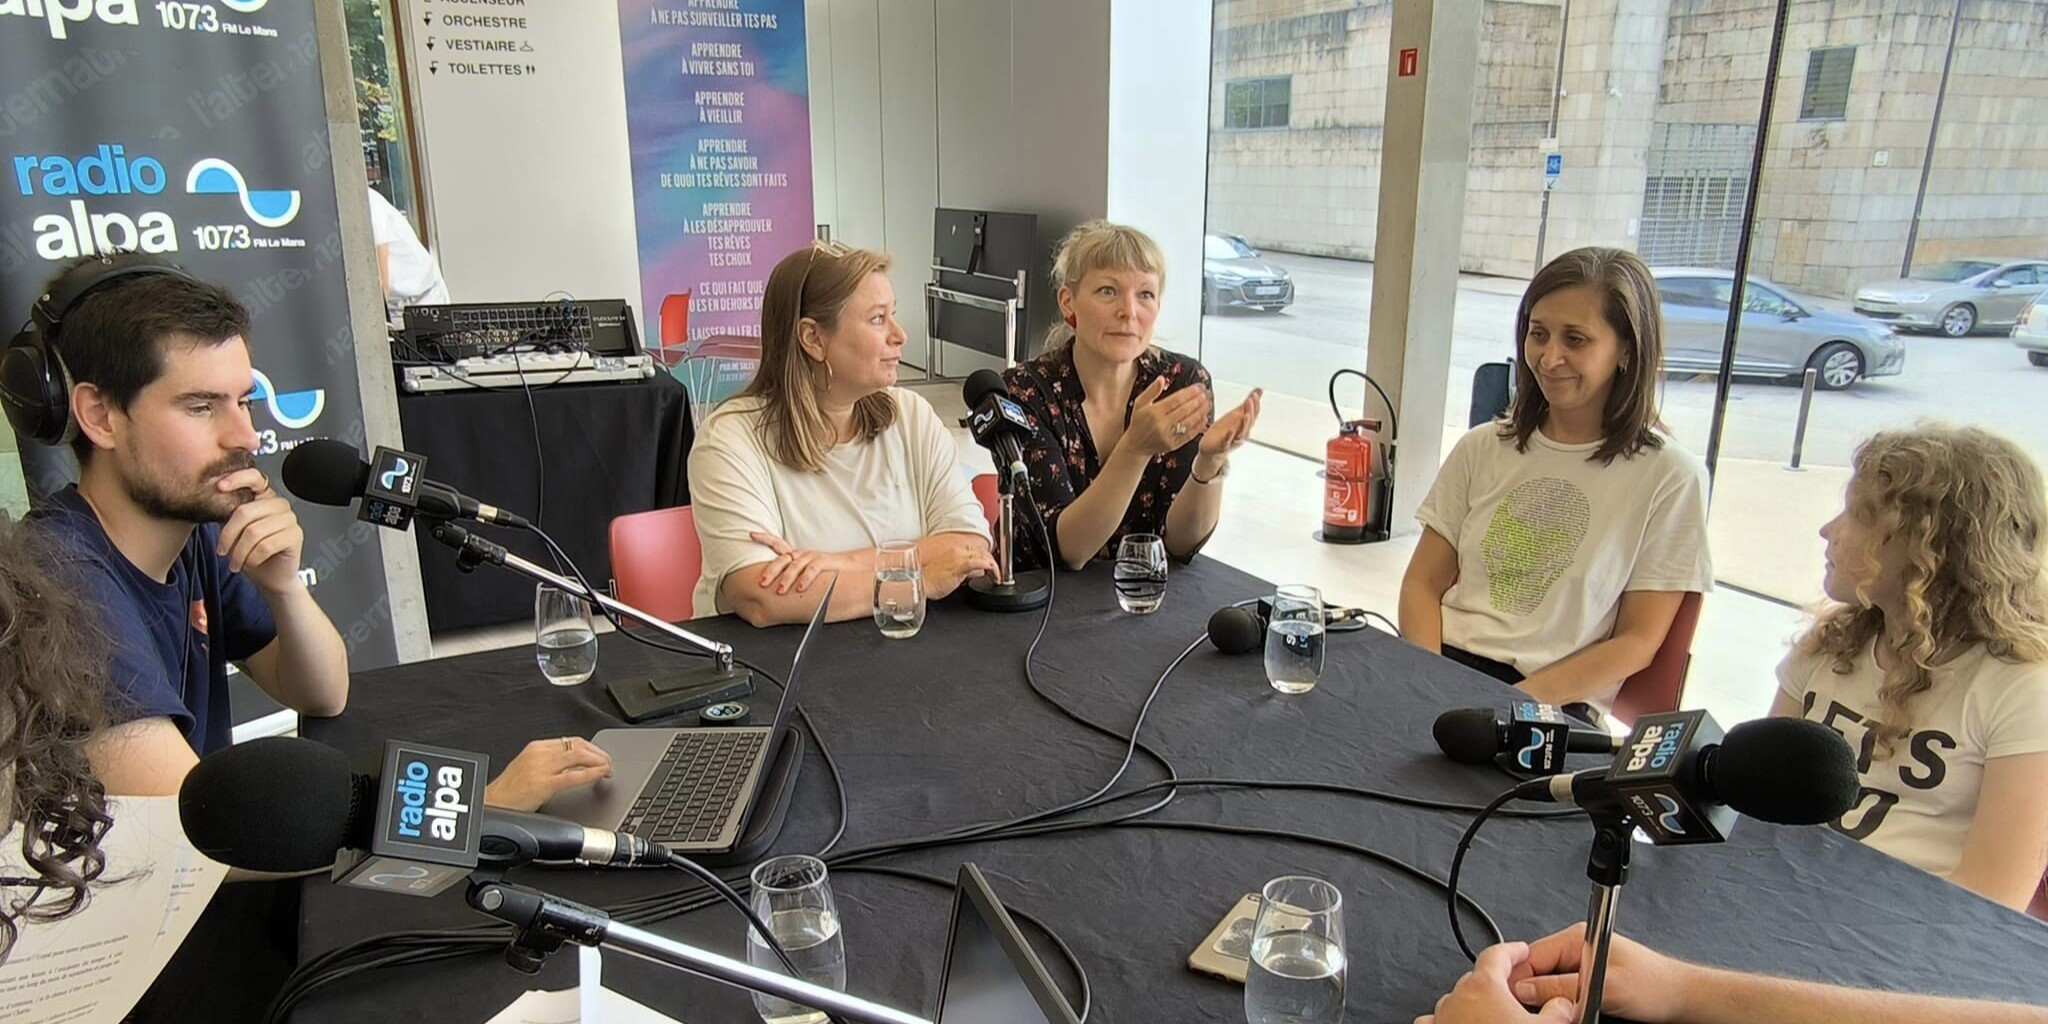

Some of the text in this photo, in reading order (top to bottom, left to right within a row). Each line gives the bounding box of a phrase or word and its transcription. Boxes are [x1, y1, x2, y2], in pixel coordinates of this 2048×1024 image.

[155, 1, 220, 32] 107.3
[442, 14, 527, 29] ORCHESTRE
[658, 11, 670, 25] NE
[672, 11, 688, 26] PAS
[690, 11, 742, 28] SURVEILLER
[744, 13, 759, 29] TES
[760, 14, 777, 29] PAS
[446, 39, 516, 52] VESTIAIRE
[691, 43, 742, 58] APPRENDRE
[448, 63, 522, 75] TOILETTES
[688, 60, 715, 75] VIVRE
[716, 61, 739, 76] SANS
[740, 62, 754, 77] TOI
[695, 91, 744, 106] APPRENDRE
[706, 109, 743, 123] VIEILLIR
[698, 139, 747, 153] APPRENDRE
[13, 144, 167, 195] radio
[697, 157, 708, 170] NE
[710, 157, 726, 170] PAS
[727, 157, 758, 170] SAVOIR
[661, 171, 788, 188] DE QUOI TES RÊVES SONT FAITS
[703, 203, 751, 216] APPRENDRE
[33, 200, 178, 260] alpa
[192, 224, 250, 250] 107.3
[690, 220, 706, 233] LES
[707, 218, 772, 232] DÉSAPPROUVER
[708, 234, 751, 250] TES RÊVES
[709, 252, 752, 266] TES CHOIX
[700, 280, 763, 296] CE QUI FAIT QUE
[720, 297, 753, 311] DEHORS
[1626, 725, 1663, 771] alpa
[1651, 721, 1684, 768] radio
[398, 761, 429, 837] radio
[425, 766, 468, 841] alpa
